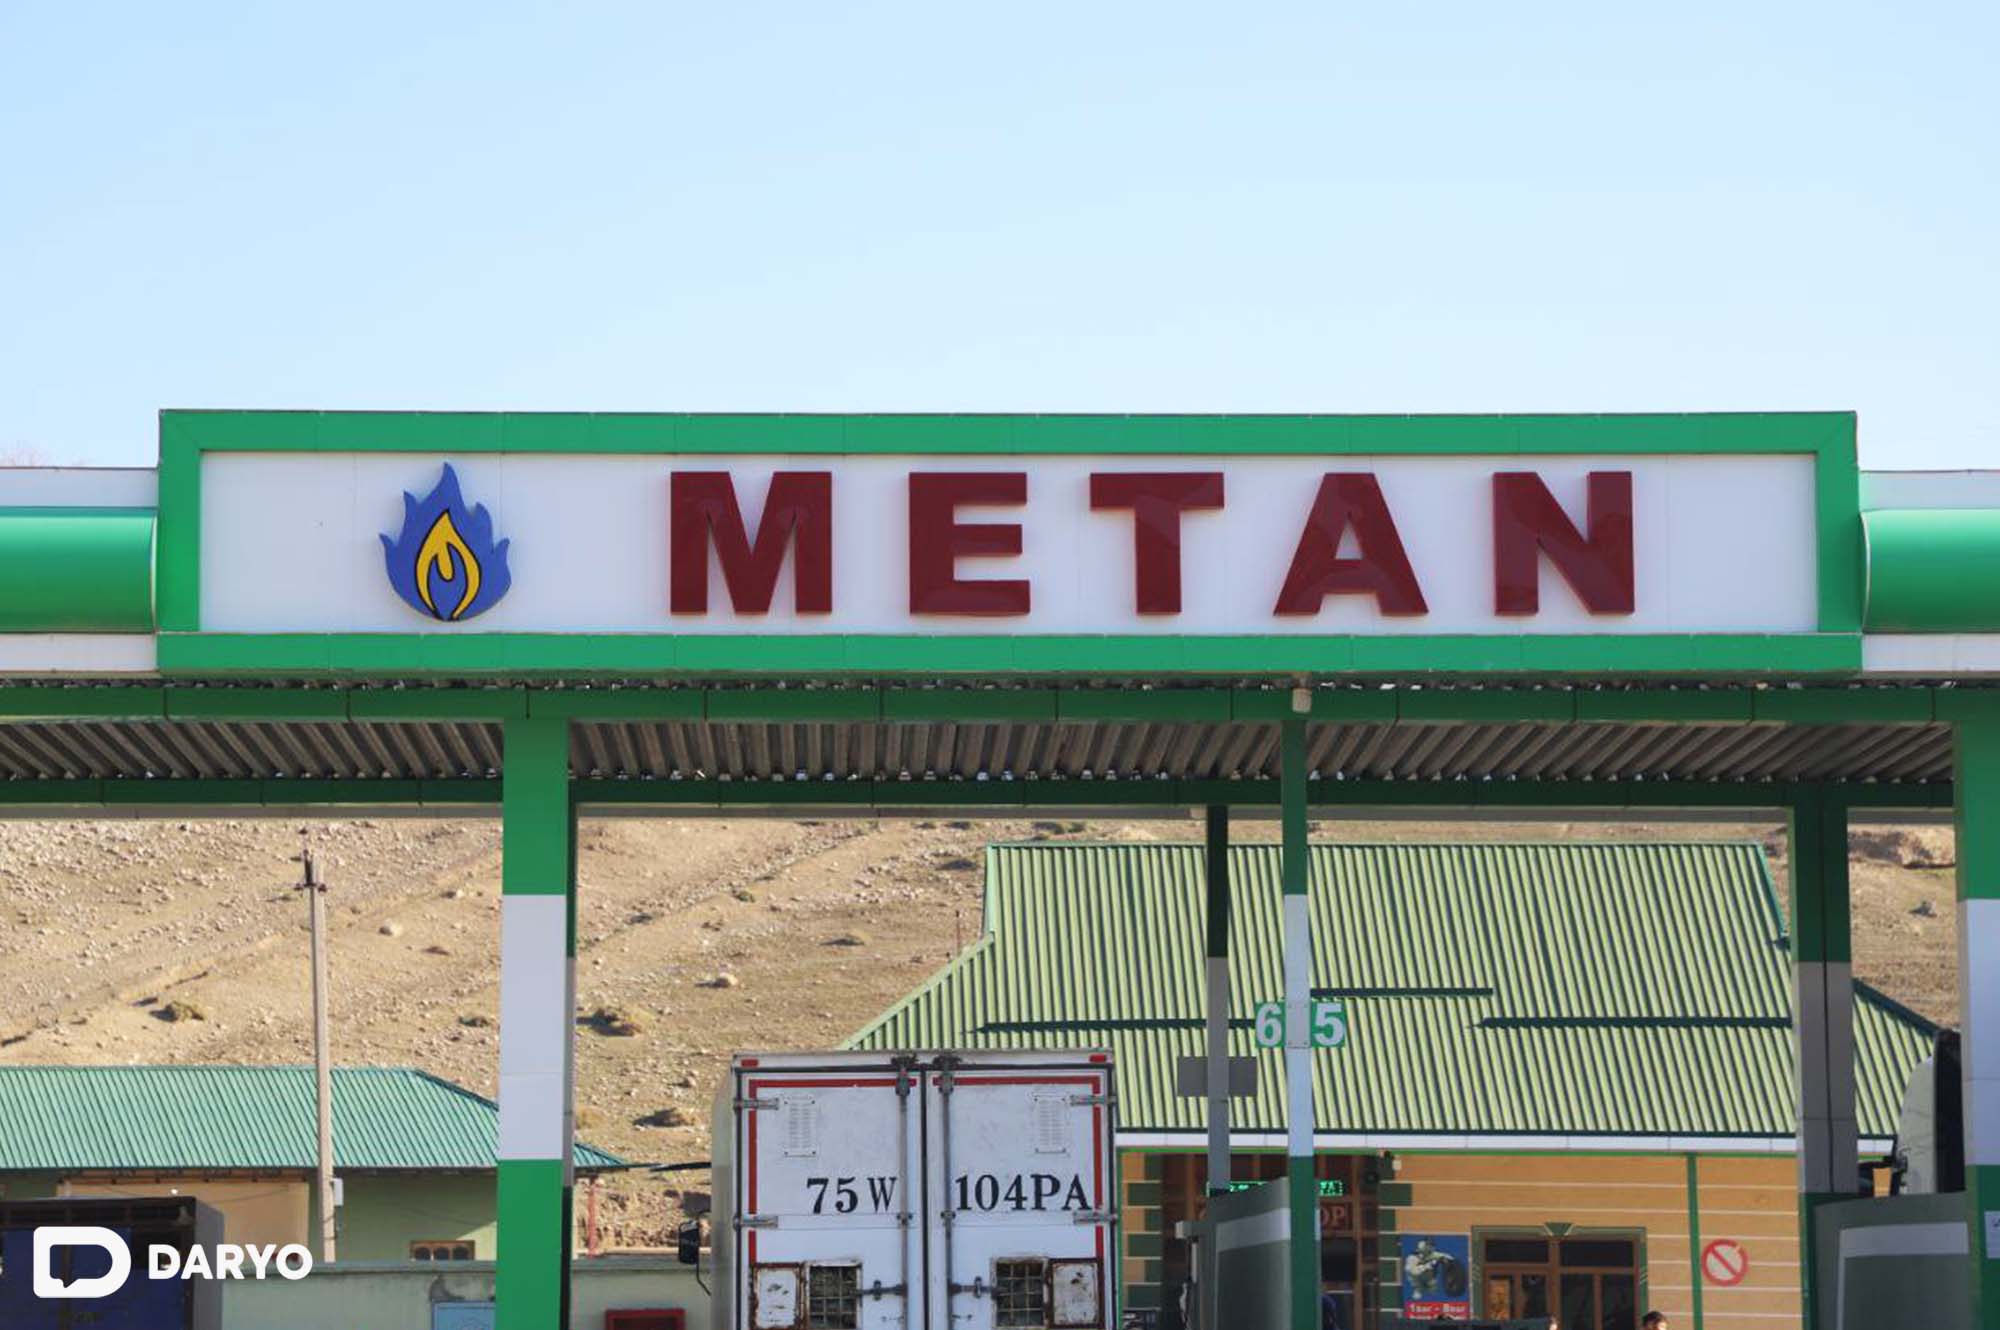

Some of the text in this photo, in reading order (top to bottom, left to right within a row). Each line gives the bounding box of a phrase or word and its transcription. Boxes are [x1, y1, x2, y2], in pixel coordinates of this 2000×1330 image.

[671, 471, 1635, 617] METAN
[1255, 1002, 1282, 1047] 6
[1315, 1003, 1345, 1046] 5
[954, 1173, 1093, 1212] 104PA
